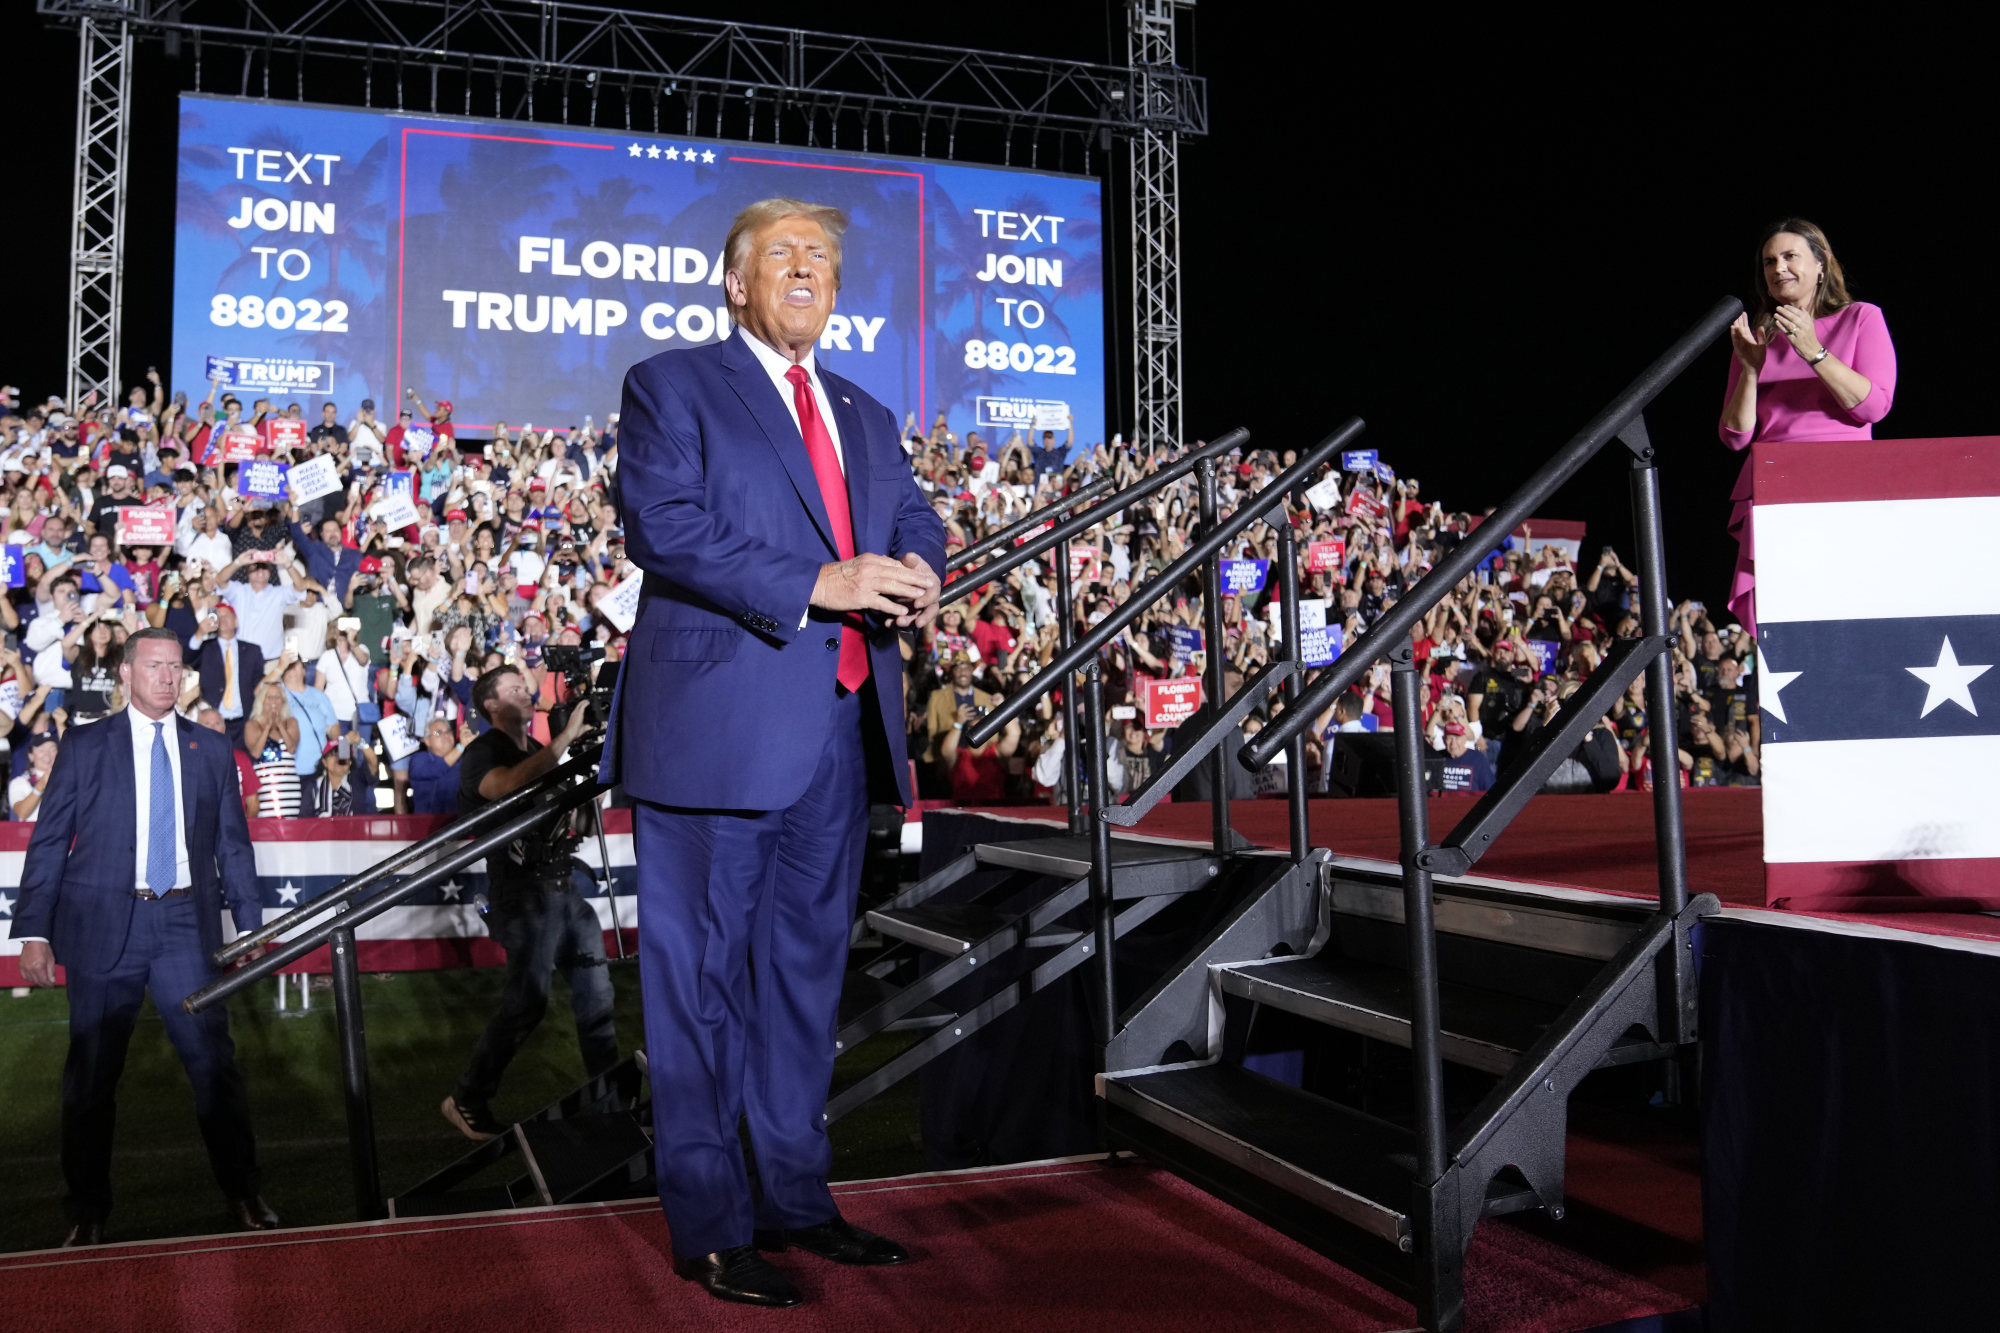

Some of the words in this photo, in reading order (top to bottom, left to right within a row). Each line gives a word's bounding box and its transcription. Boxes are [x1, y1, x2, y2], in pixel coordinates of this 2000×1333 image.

[227, 147, 341, 186] TEXT
[227, 197, 336, 235] JOIN
[973, 208, 1065, 244] TEXT
[250, 246, 312, 282] TO
[976, 253, 1063, 288] JOIN
[209, 293, 349, 333] 88022
[996, 298, 1045, 329] TO
[442, 289, 627, 336] TRUMP
[640, 301, 886, 352] COURY
[964, 339, 1077, 375] 88022
[238, 363, 321, 383] TRUMP
[986, 401, 1042, 419] TRUM
[244, 468, 286, 481] AMERICA
[252, 462, 279, 473] MAKE
[299, 463, 319, 474] MAKE
[249, 477, 280, 488] GREAT
[296, 468, 328, 484] AMERICA
[128, 510, 166, 519] FLORIDA
[132, 525, 162, 533] TRUMP
[126, 532, 168, 541] COUNTRY
[1225, 569, 1262, 577] AMERICA
[1301, 636, 1336, 648] MERICA
[1158, 684, 1195, 694] FLORIDA
[1175, 694, 1184, 703] IS
[1162, 702, 1193, 712] TRUMP
